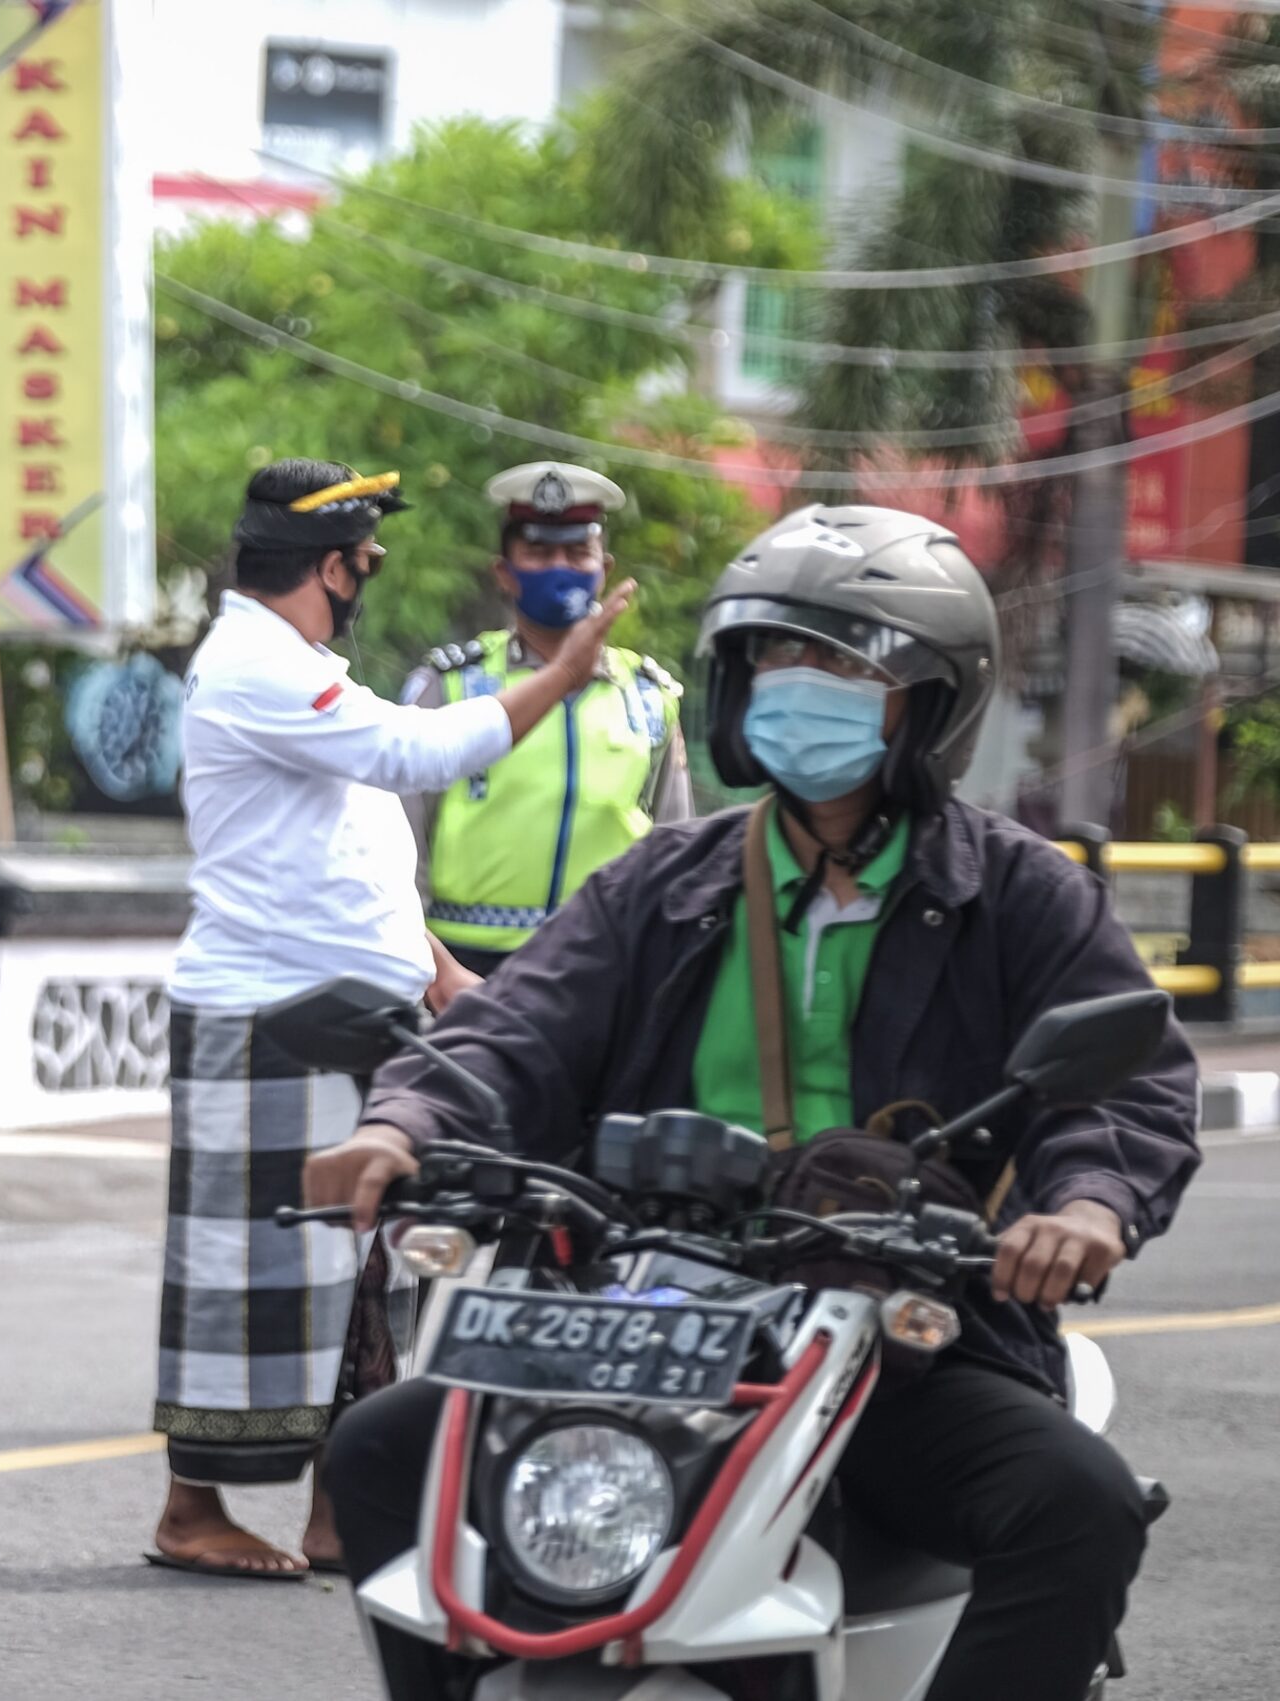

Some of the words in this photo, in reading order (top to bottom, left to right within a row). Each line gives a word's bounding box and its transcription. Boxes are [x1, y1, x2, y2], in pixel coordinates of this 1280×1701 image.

[11, 57, 66, 238] KAIN
[14, 277, 69, 542] MASKER
[454, 1296, 523, 1343] DK
[530, 1306, 656, 1353] 2678
